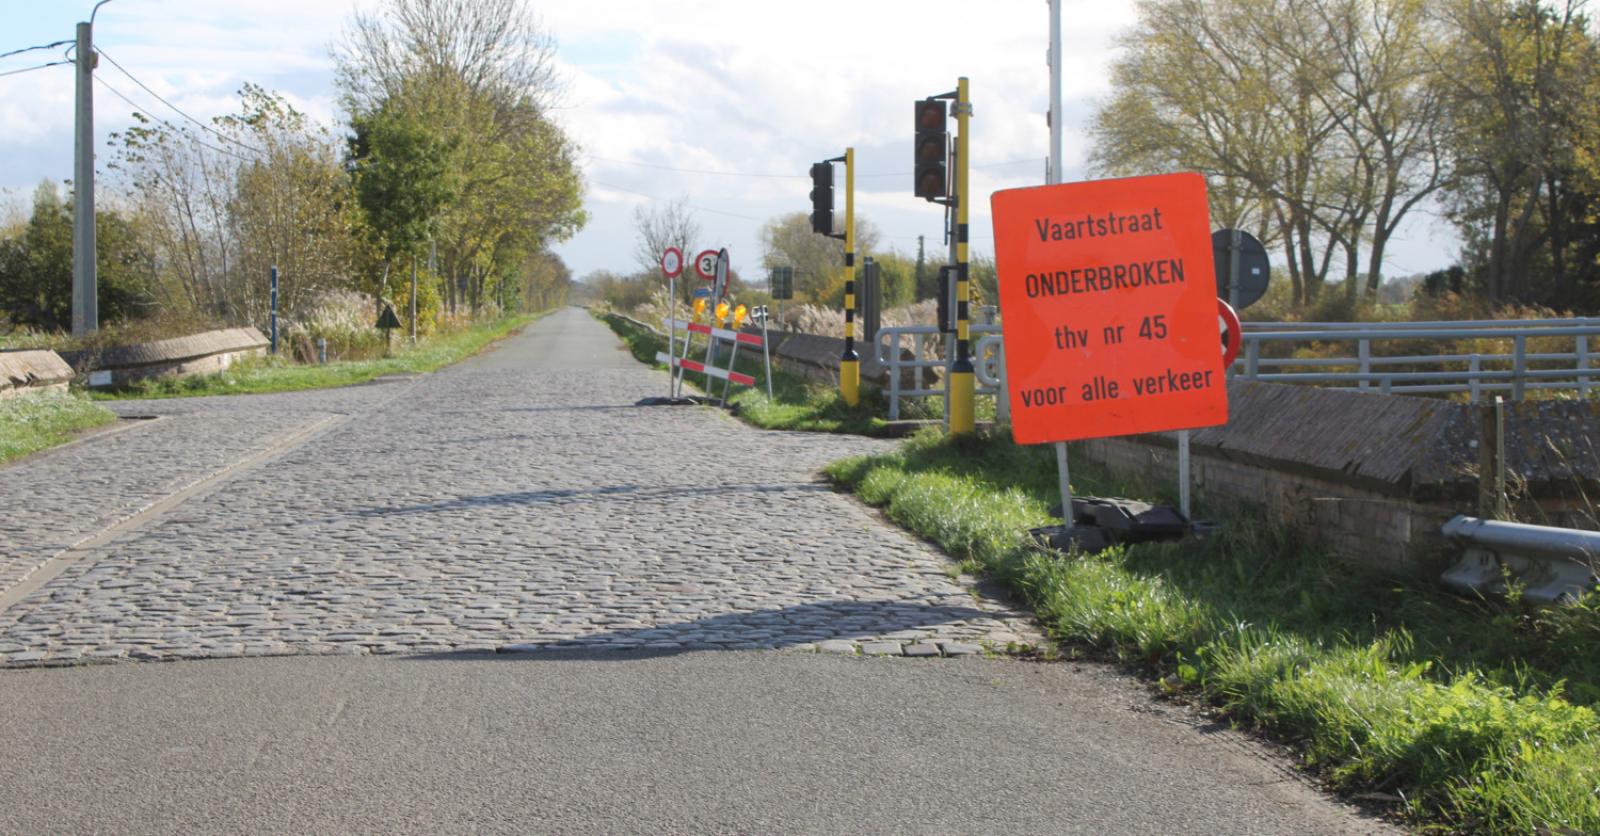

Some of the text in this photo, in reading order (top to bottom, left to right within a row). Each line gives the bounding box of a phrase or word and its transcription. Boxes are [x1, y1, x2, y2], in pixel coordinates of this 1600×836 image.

[1035, 207, 1162, 242] Vaartstraat
[1025, 258, 1185, 298] ONDERBROKEN
[1054, 315, 1168, 349] thv nr 45
[1021, 368, 1213, 407] voor alle verkeer
